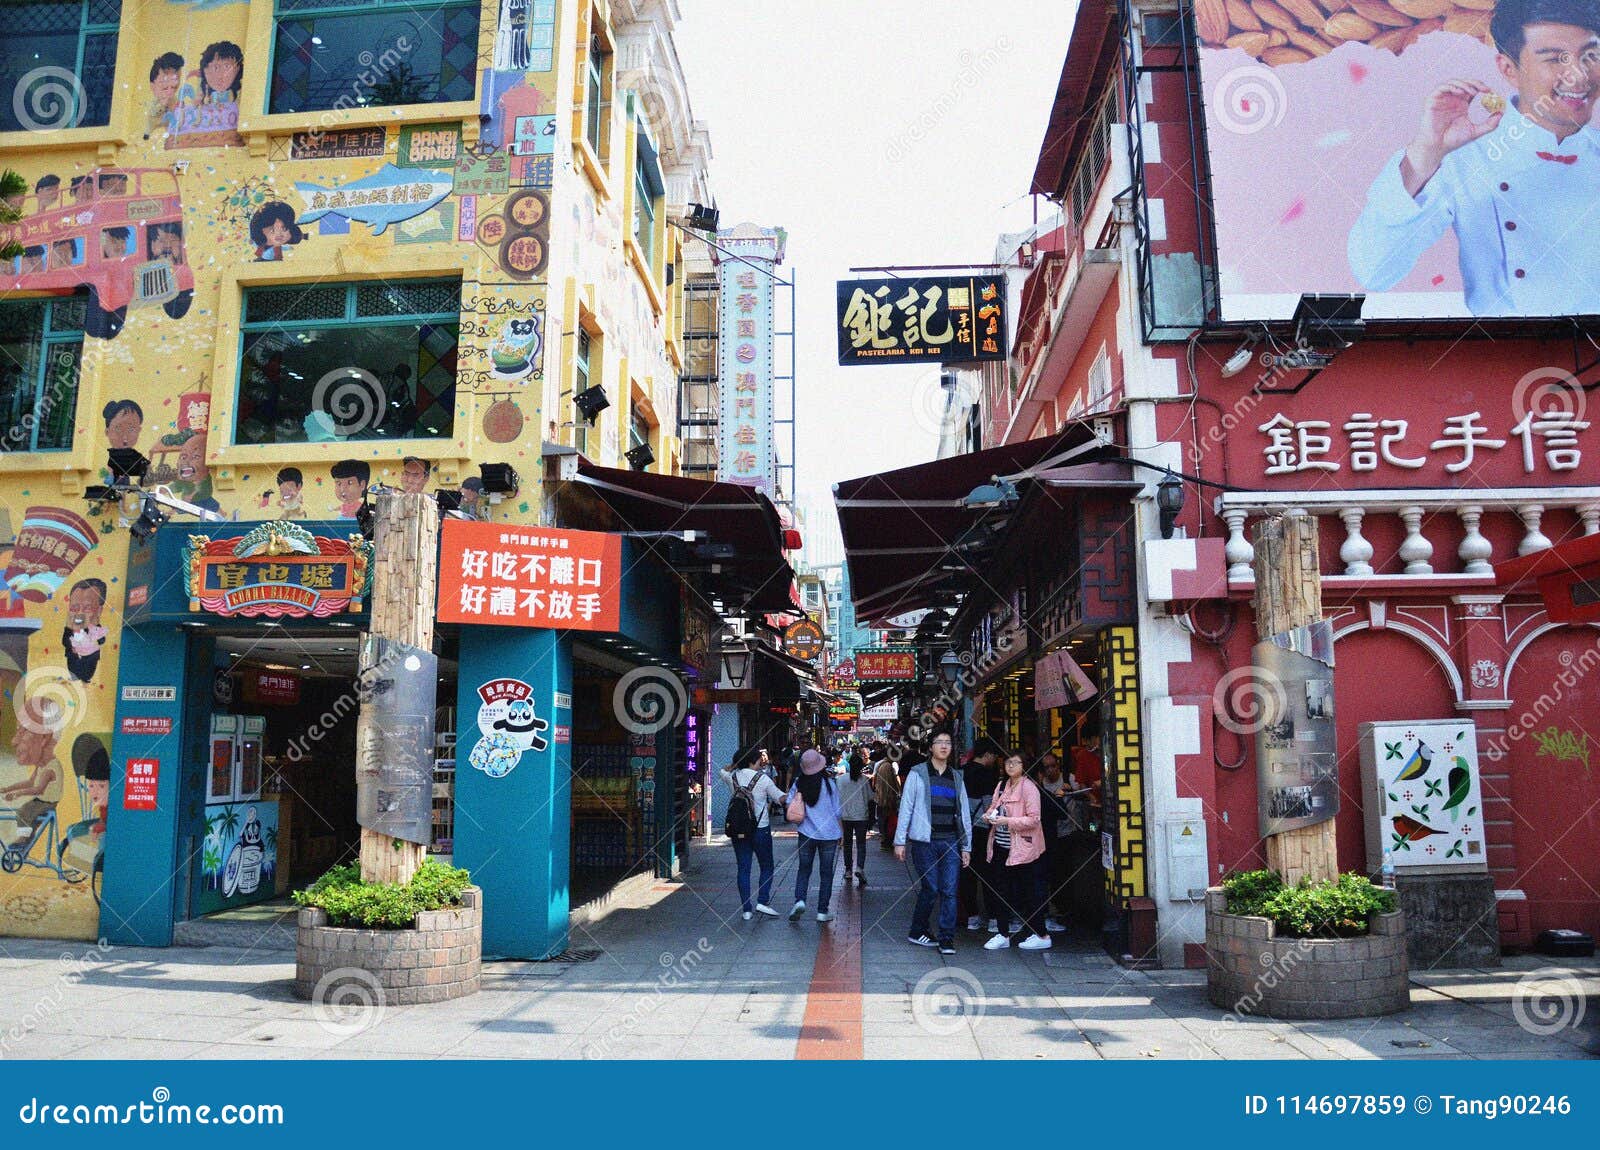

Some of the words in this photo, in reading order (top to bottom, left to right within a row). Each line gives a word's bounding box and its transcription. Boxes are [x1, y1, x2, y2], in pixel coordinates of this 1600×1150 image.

[857, 348, 905, 356] PASTELARIA
[1258, 411, 1591, 474] 鉅記手信
[216, 564, 333, 588] 官也墟
[461, 548, 602, 587] 好吃不離口
[460, 584, 601, 621] 好禮不放手
